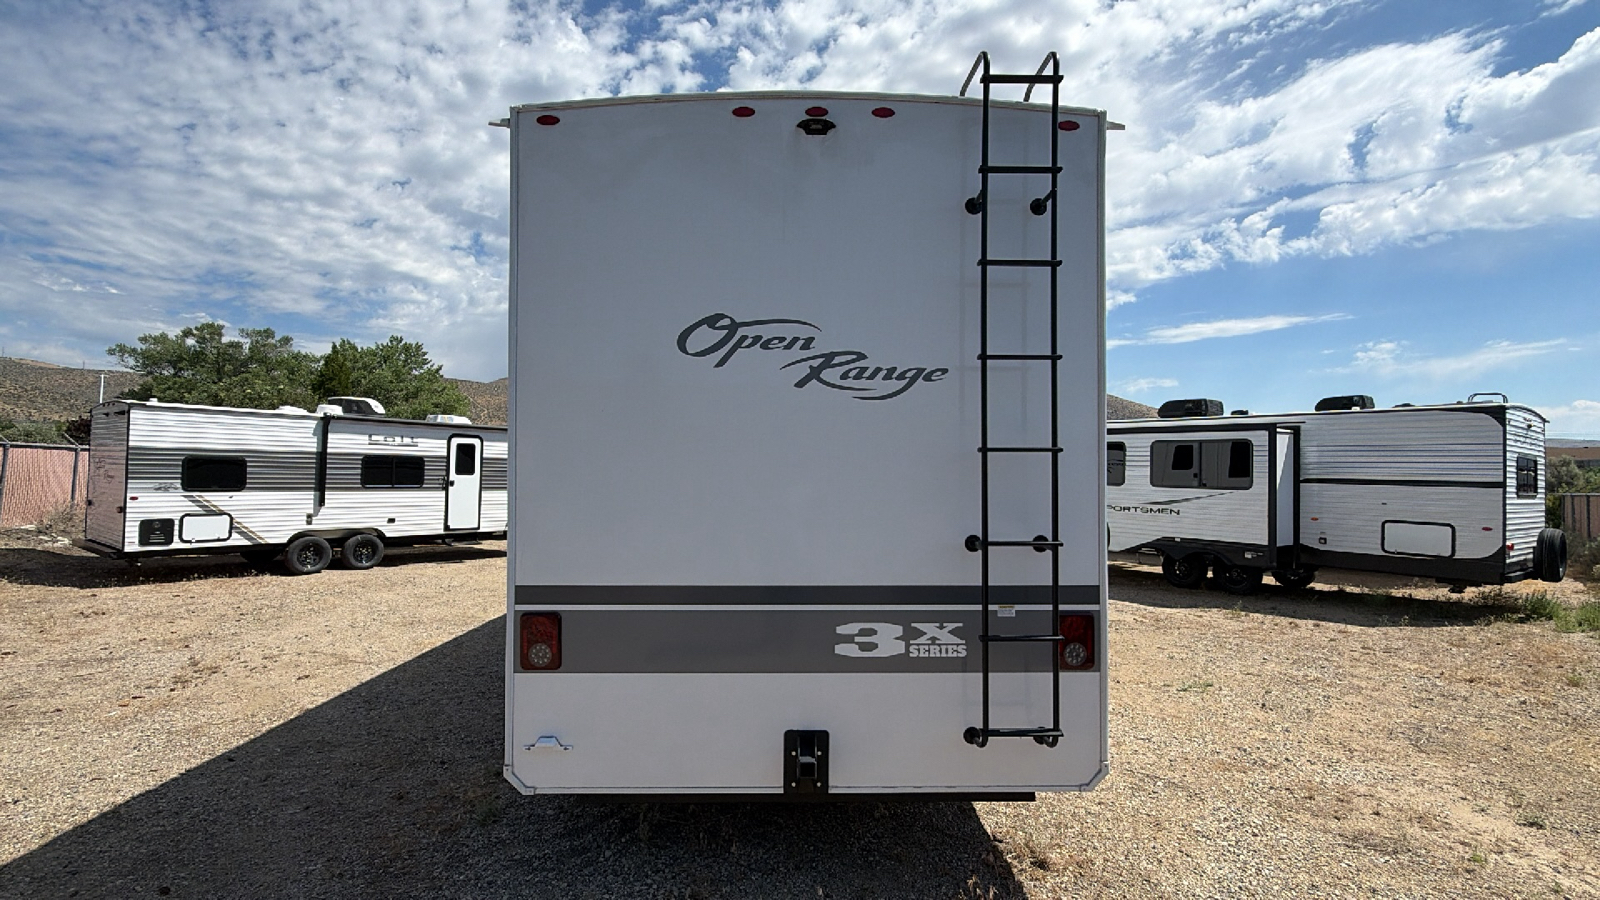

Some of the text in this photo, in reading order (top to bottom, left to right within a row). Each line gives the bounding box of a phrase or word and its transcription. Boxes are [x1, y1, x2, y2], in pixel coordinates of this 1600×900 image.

[677, 313, 822, 368] Open
[779, 350, 949, 400] Range
[834, 622, 966, 657] 3 X
[909, 644, 967, 658] SERIES
